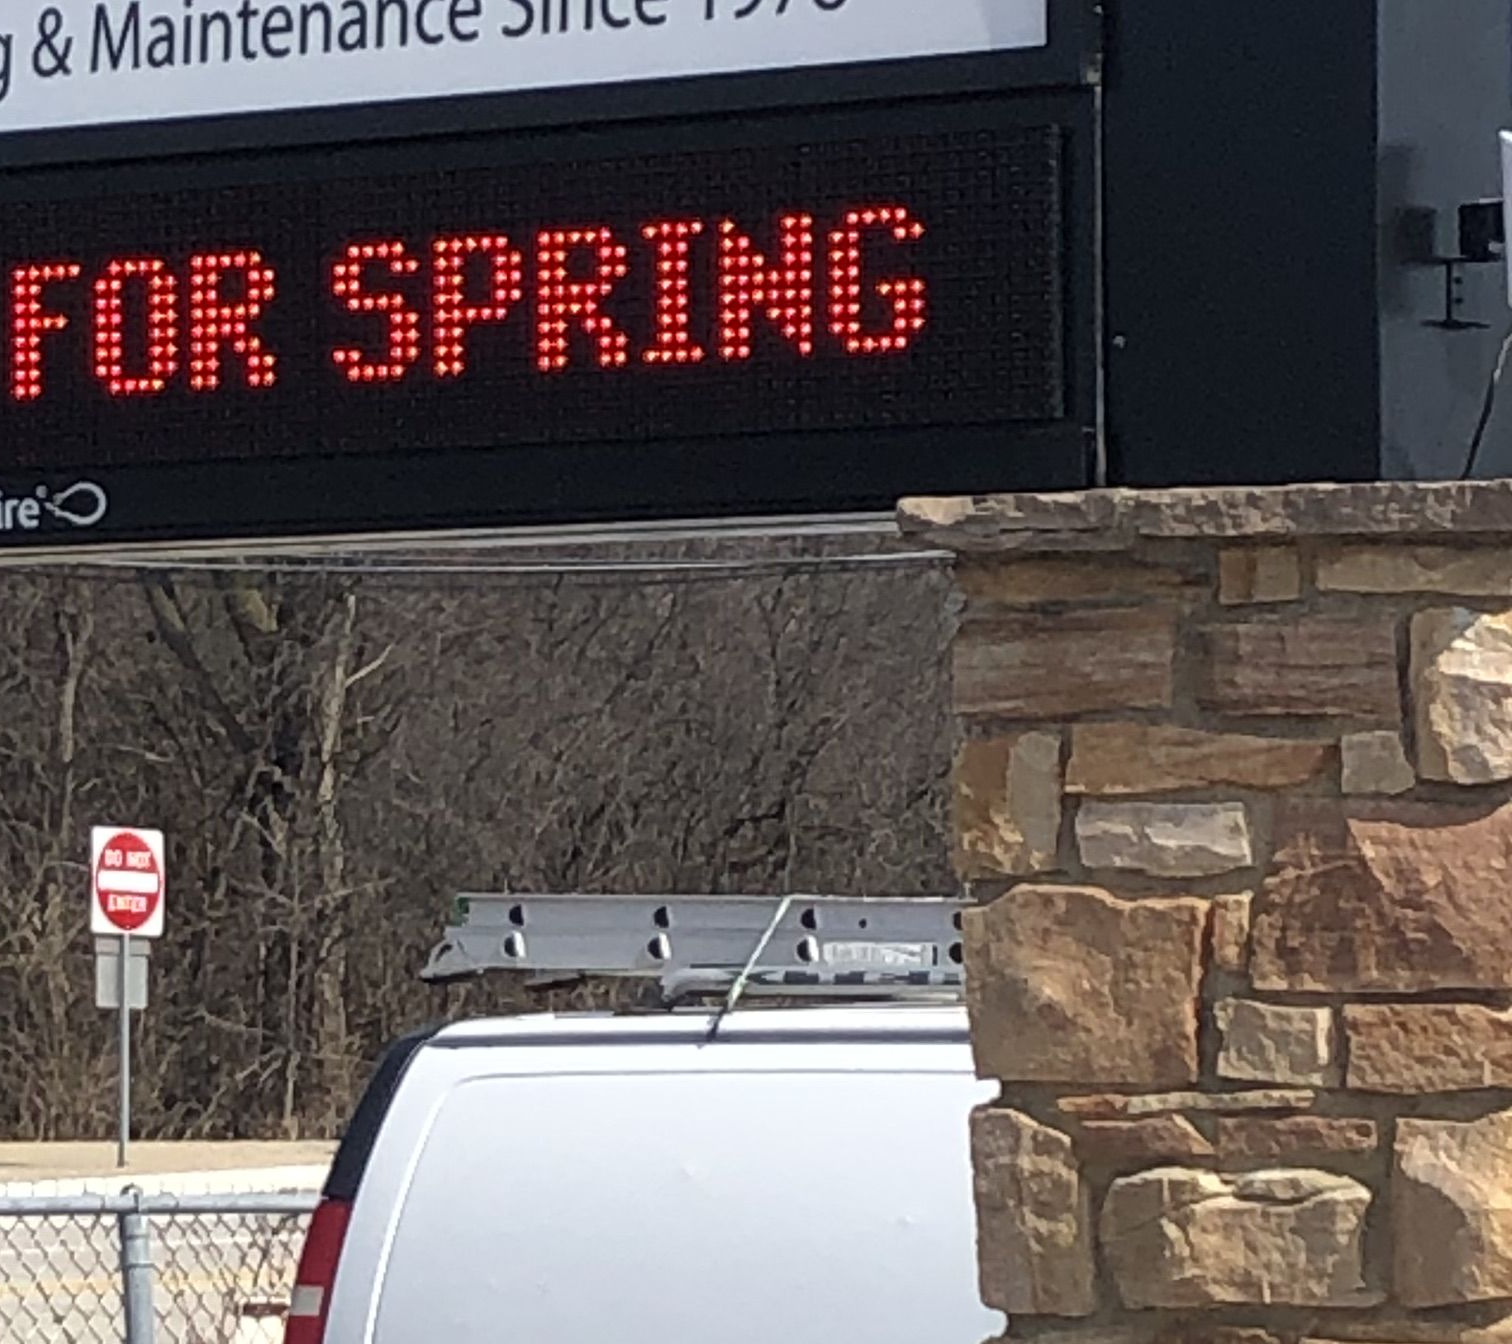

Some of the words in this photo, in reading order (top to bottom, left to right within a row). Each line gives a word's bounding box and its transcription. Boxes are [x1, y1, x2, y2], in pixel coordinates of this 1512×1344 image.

[31, 6, 74, 79] &
[10, 251, 276, 399] FOR
[331, 206, 926, 382] SPRING
